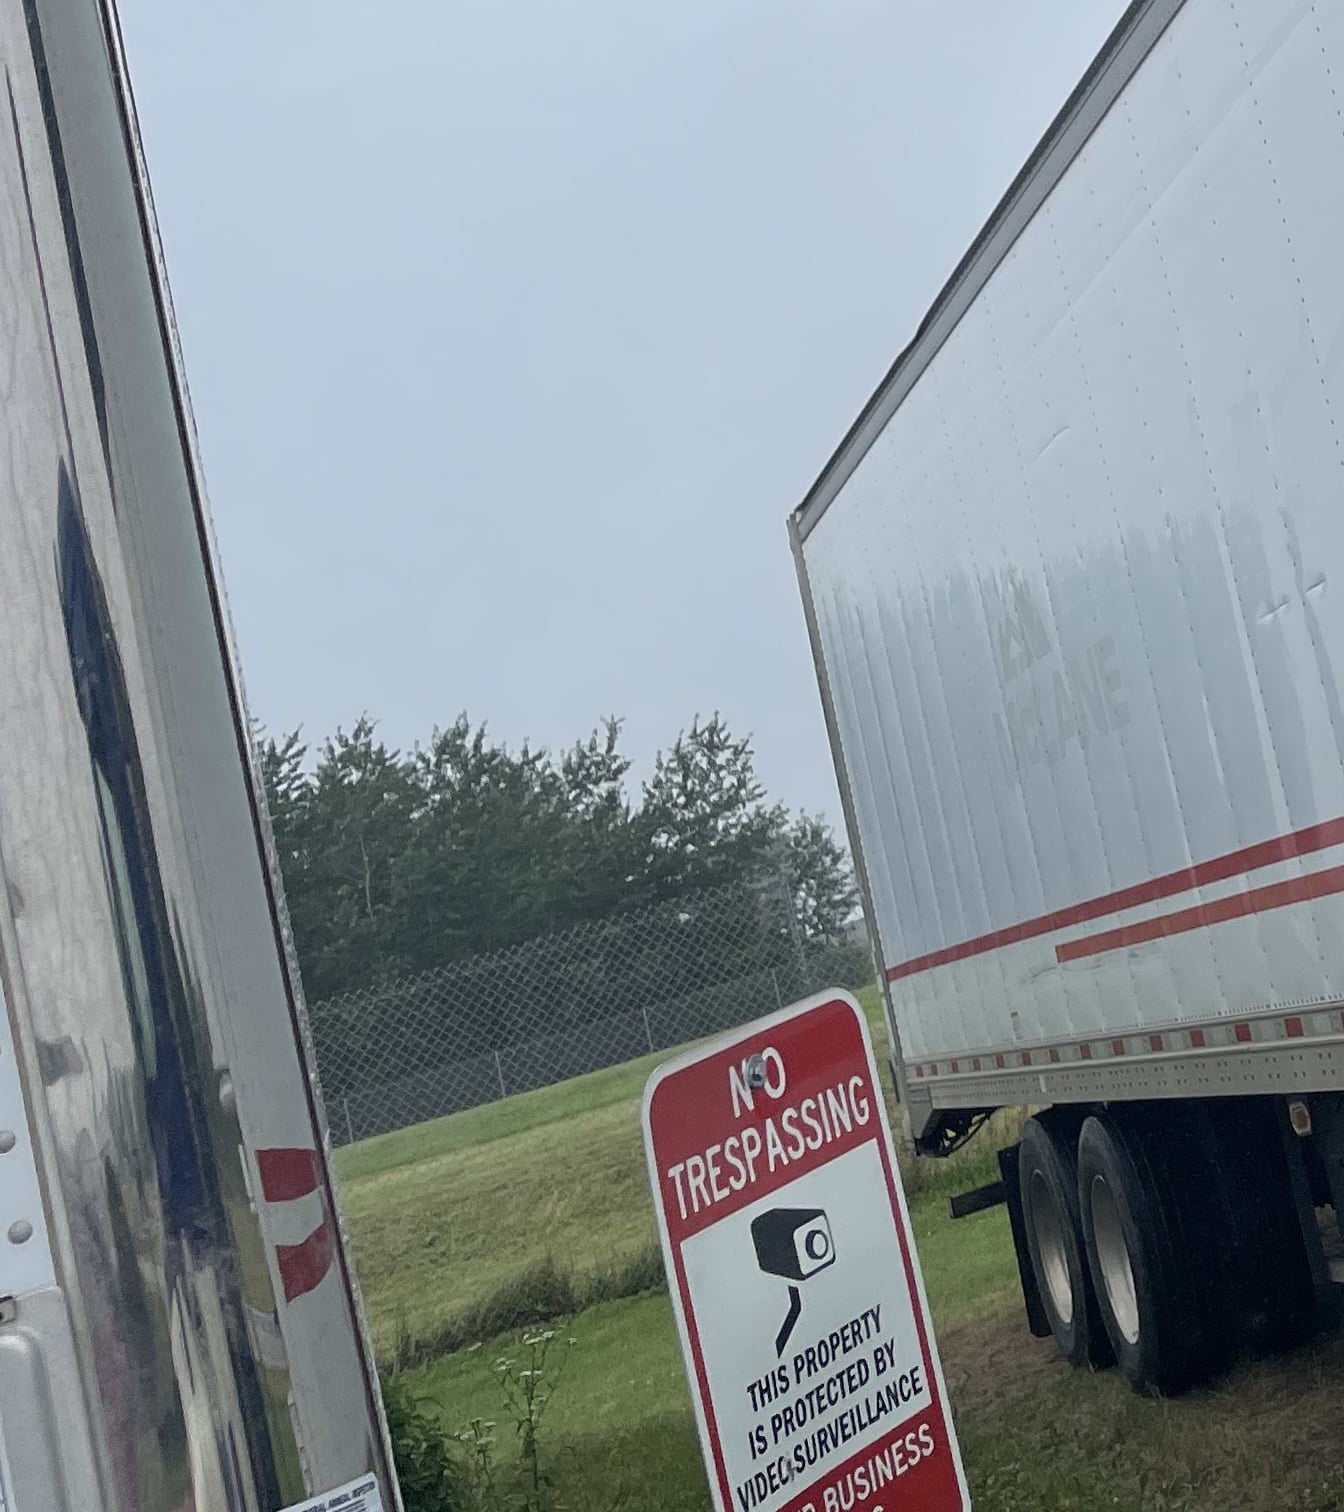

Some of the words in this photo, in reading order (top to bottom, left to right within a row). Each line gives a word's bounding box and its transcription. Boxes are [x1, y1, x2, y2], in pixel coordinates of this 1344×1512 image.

[728, 1046, 786, 1119] NO
[667, 1075, 870, 1220] TRESPASSING
[746, 1365, 790, 1413] THIS
[793, 1303, 881, 1385] PROPERTY
[748, 1424, 768, 1460] IS
[770, 1357, 870, 1445] PROTECTED
[873, 1337, 895, 1376] BY
[736, 1455, 794, 1512] VIDEO
[793, 1365, 924, 1474] SURVEILLANCE
[822, 1423, 935, 1512] BUSINESS
